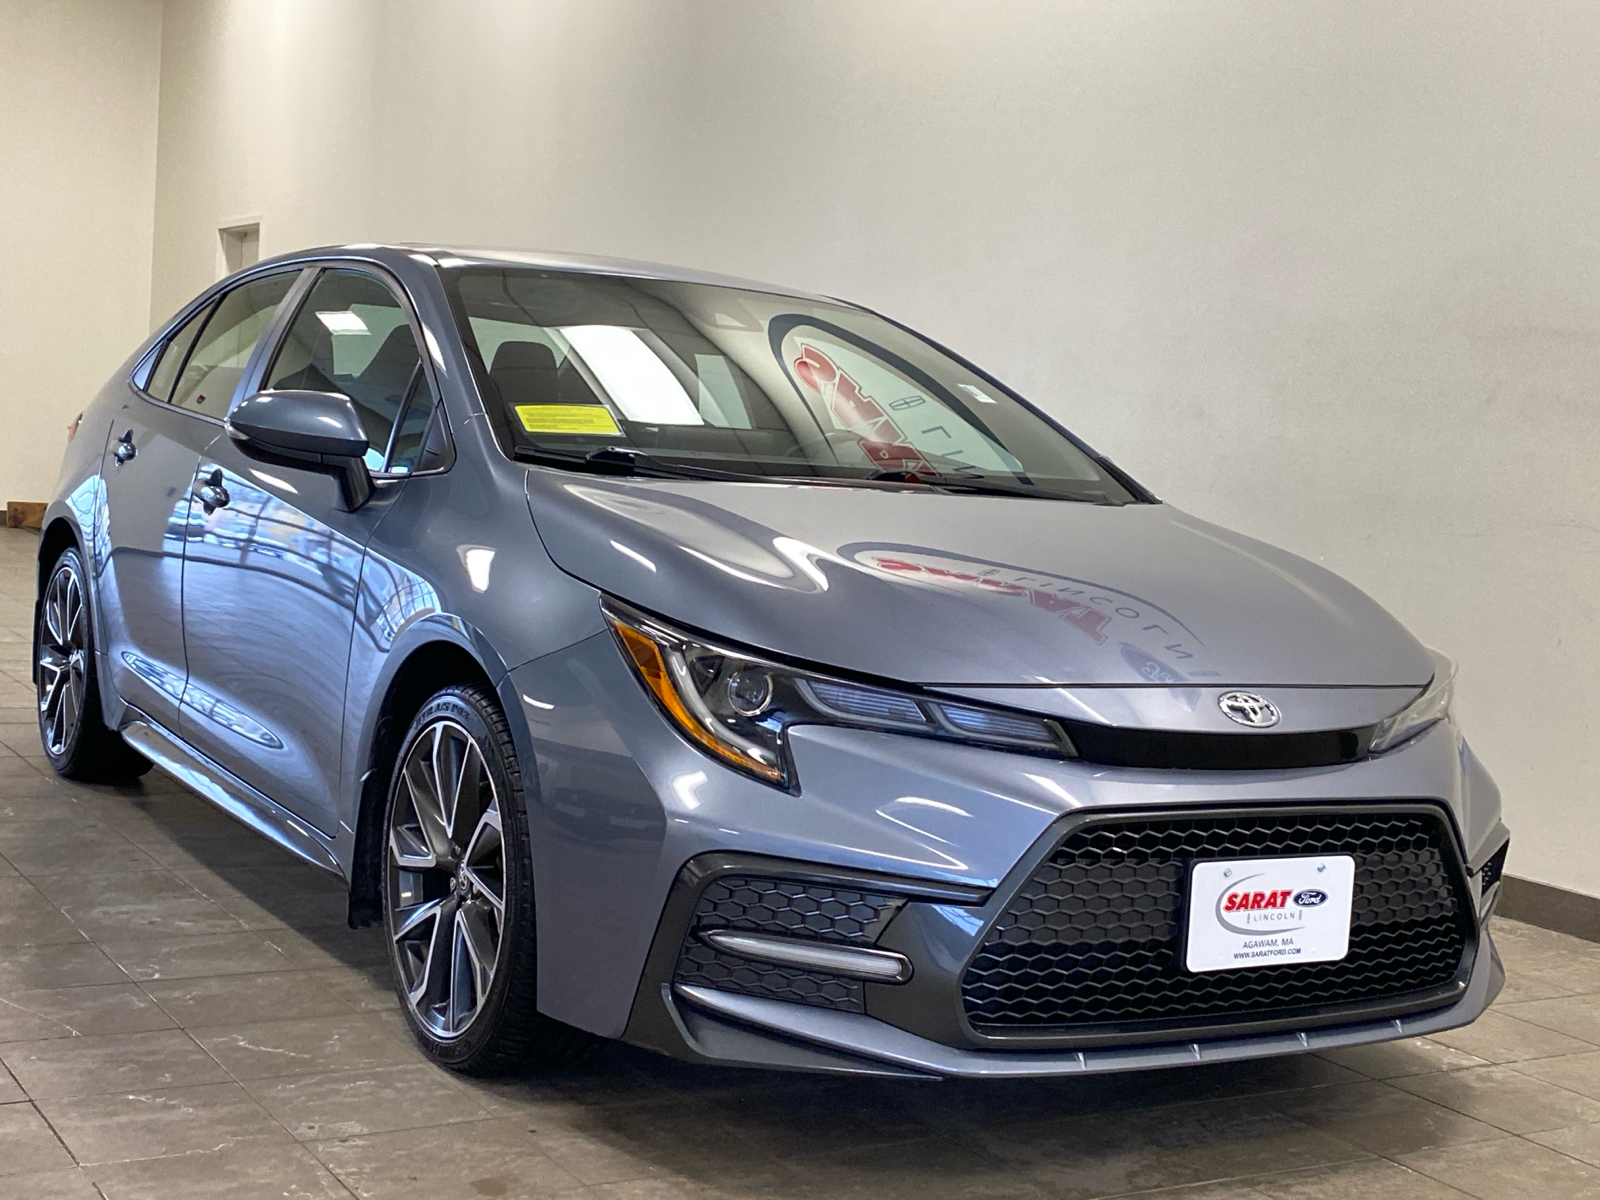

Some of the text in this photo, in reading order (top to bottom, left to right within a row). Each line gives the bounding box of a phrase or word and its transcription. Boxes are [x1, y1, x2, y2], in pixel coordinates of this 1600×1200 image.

[1223, 889, 1322, 913] SARAT Ford
[1253, 912, 1296, 922] LINCOLN
[1242, 937, 1294, 949] AGAWAM, MA
[1233, 948, 1302, 960] WWW.SARATFORD.COM
